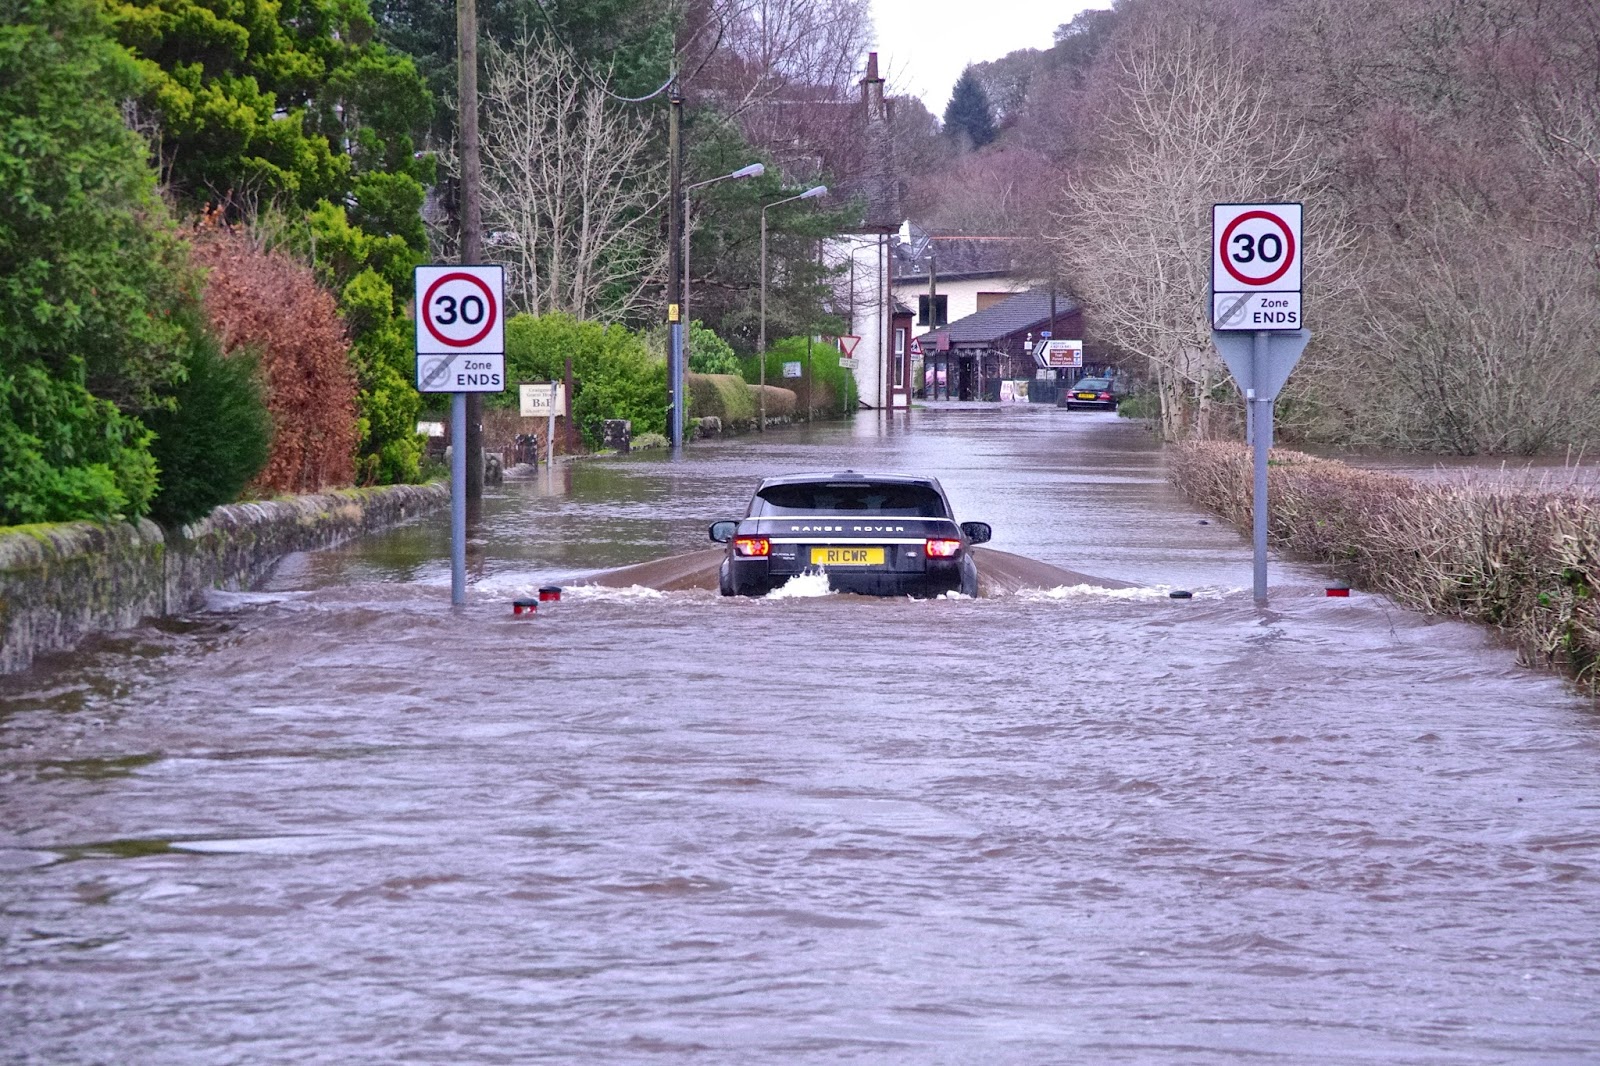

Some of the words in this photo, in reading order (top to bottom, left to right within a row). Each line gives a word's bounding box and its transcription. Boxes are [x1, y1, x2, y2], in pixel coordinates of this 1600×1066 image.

[1232, 233, 1283, 263] 30
[1261, 298, 1289, 308] Zone
[435, 295, 484, 325] 30
[1253, 312, 1297, 323] ENDS
[464, 361, 492, 370] Zone
[457, 374, 500, 385] ENDS
